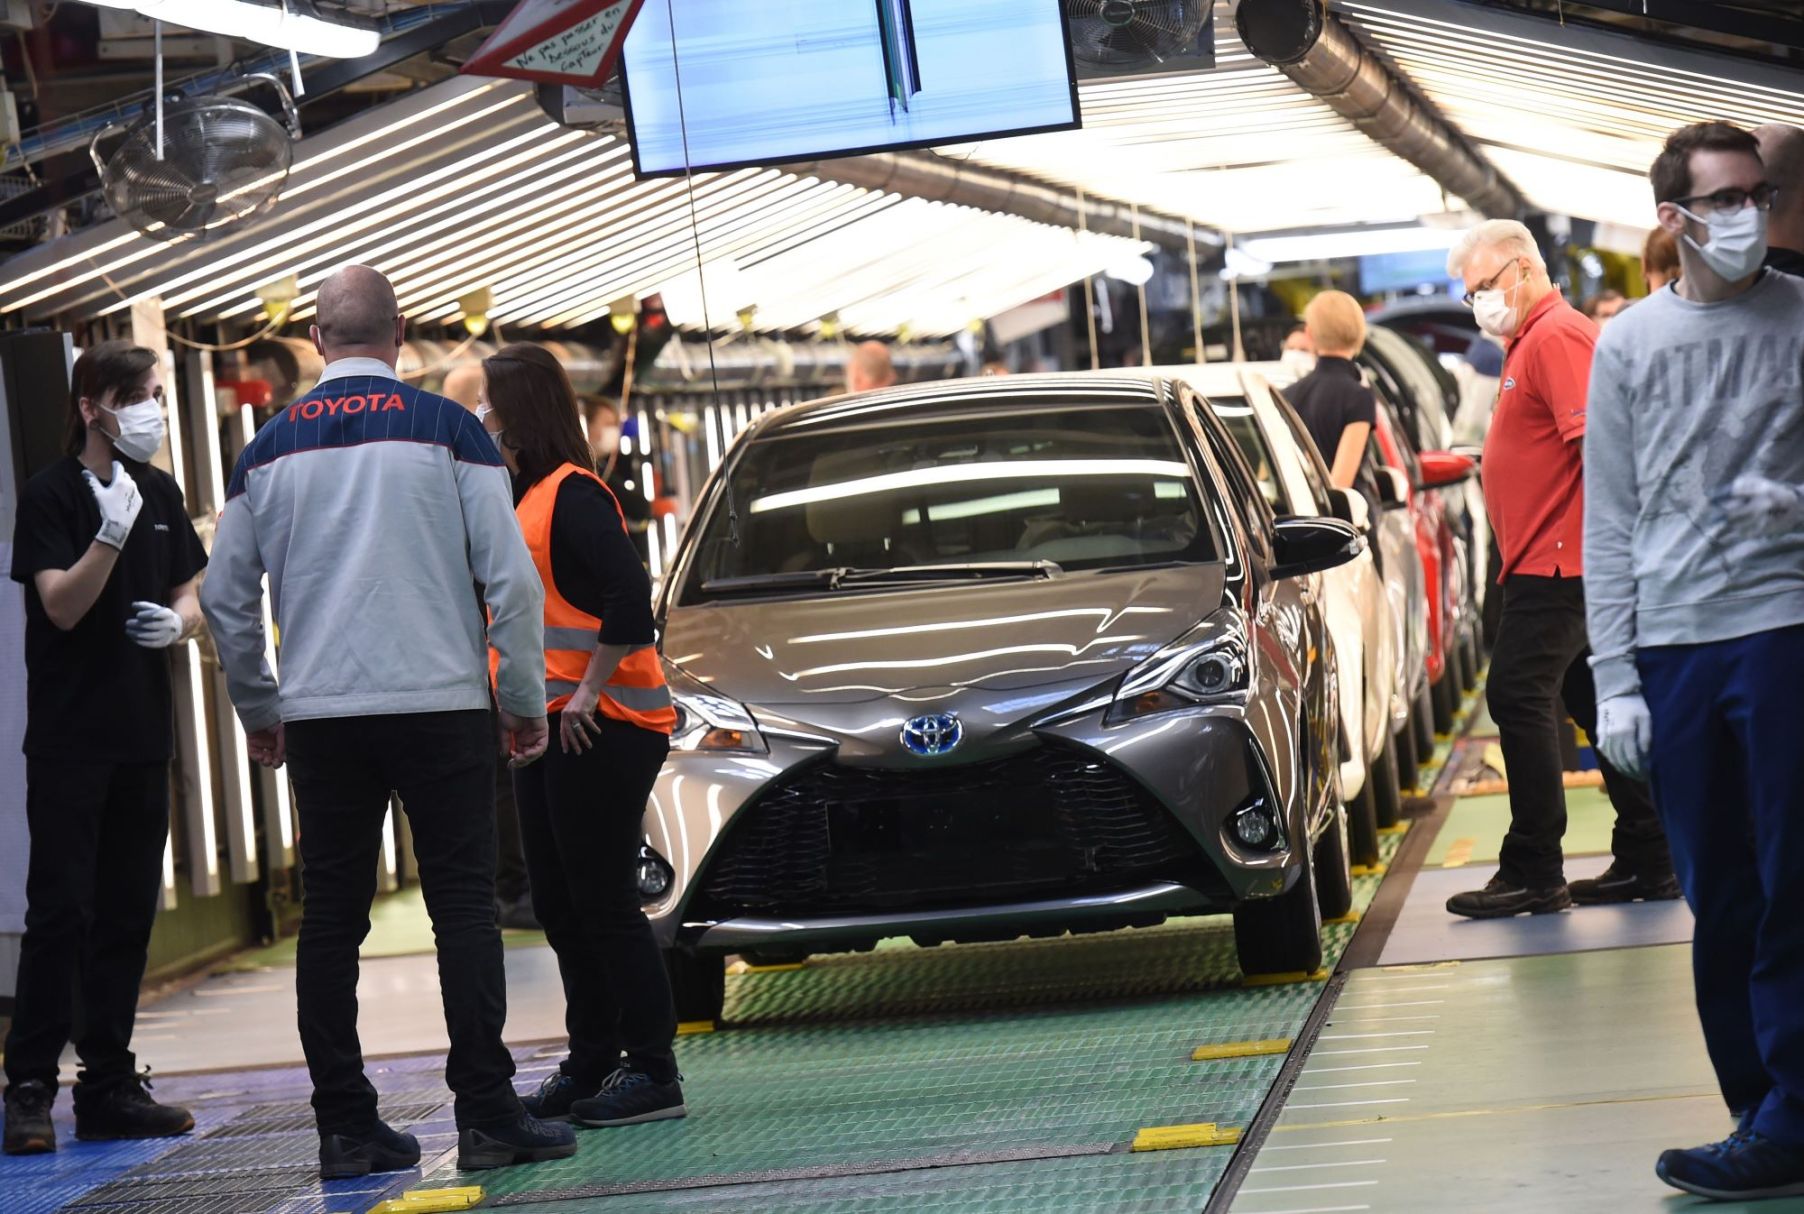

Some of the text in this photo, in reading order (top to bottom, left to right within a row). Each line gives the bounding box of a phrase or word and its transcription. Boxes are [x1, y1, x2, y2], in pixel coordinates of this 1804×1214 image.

[515, 7, 620, 69] Ne pas passer en
[600, 23, 615, 36] du
[288, 394, 405, 422] TOYOTA
